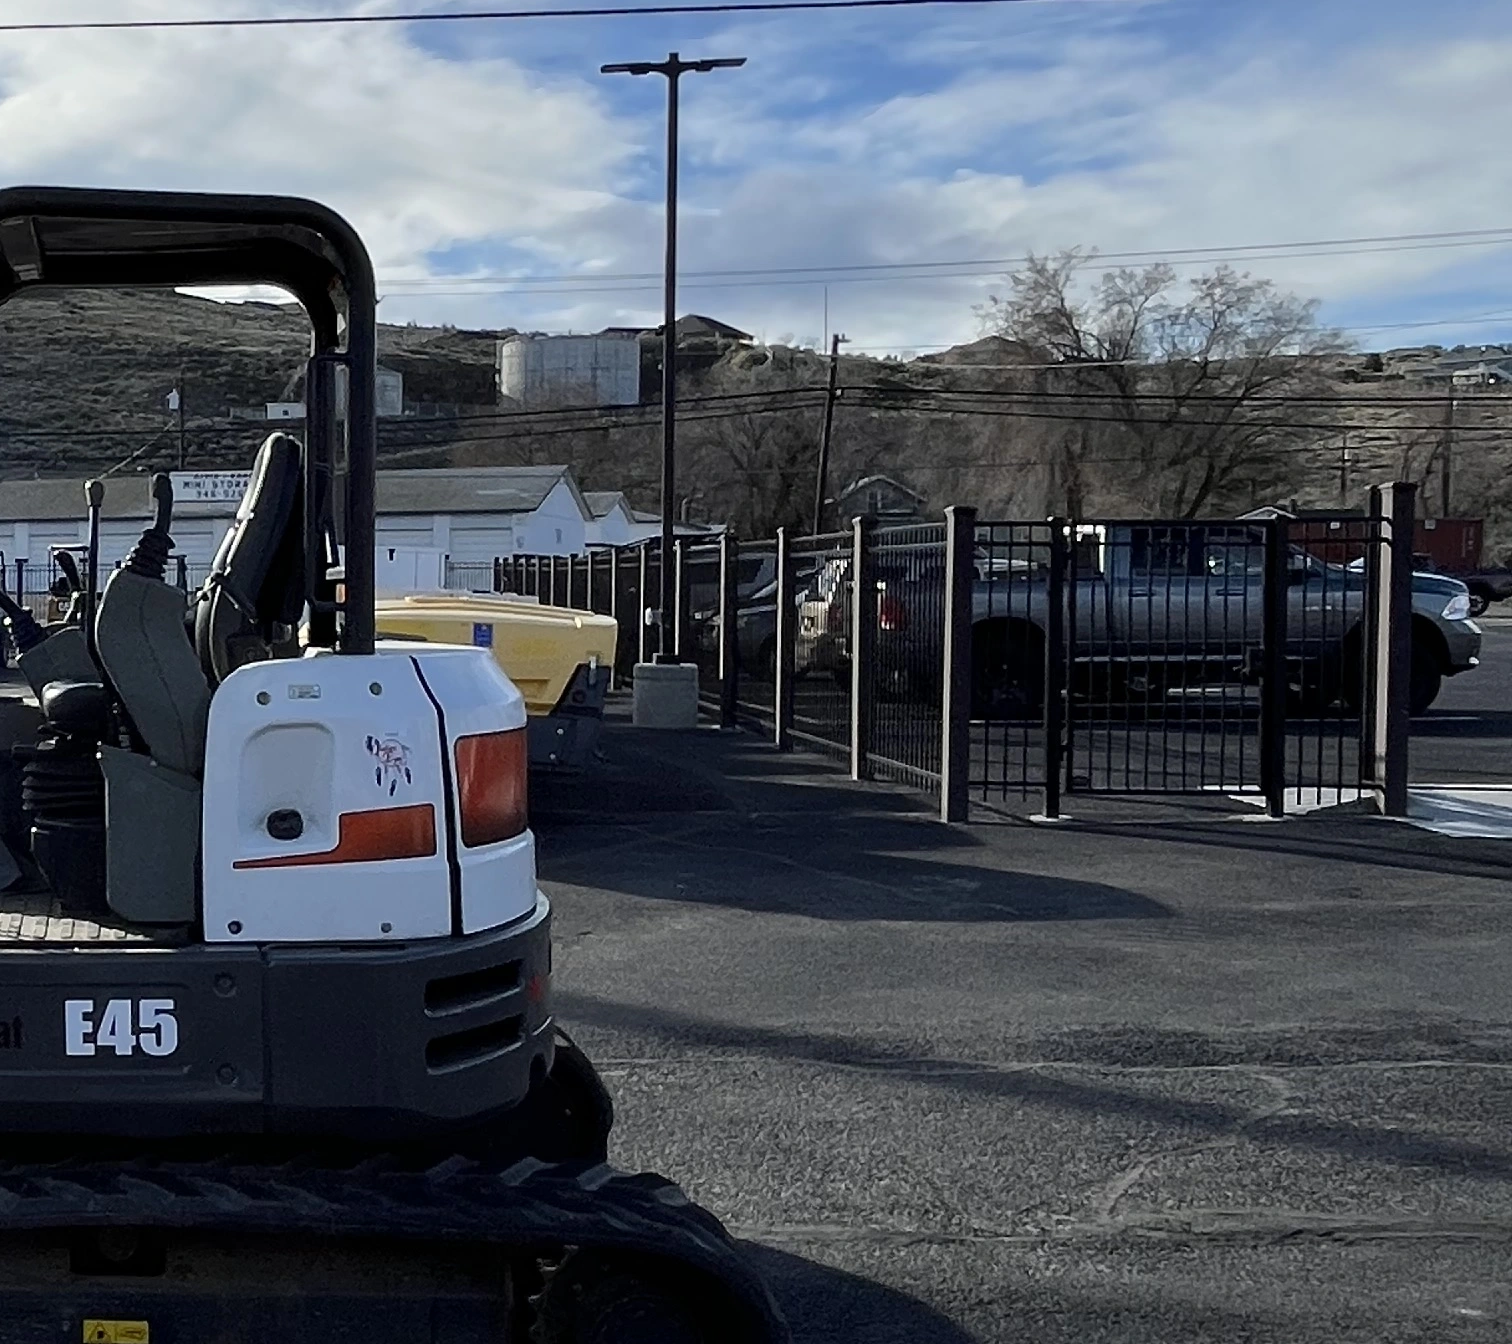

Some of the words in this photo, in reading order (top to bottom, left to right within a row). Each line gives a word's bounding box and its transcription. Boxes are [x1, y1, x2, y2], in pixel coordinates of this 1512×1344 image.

[183, 480, 206, 489] MINI
[212, 480, 248, 490] STORA
[64, 999, 178, 1056] E45
